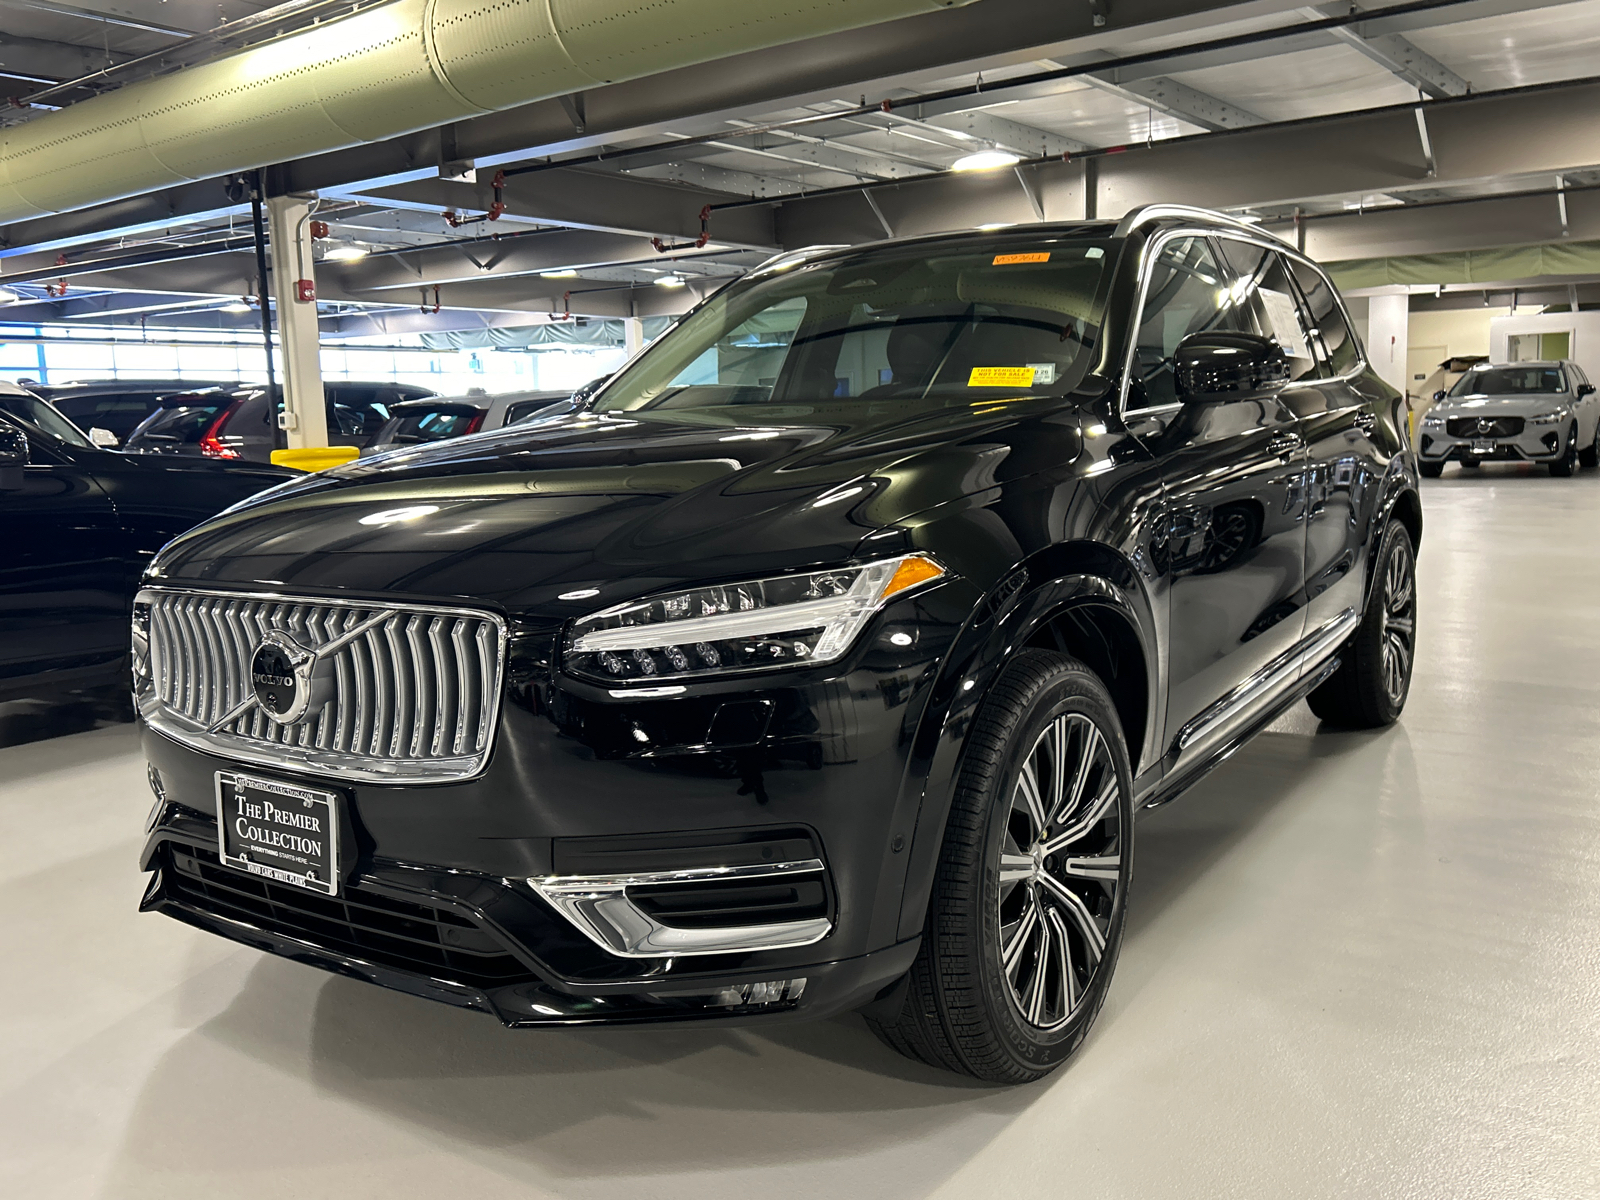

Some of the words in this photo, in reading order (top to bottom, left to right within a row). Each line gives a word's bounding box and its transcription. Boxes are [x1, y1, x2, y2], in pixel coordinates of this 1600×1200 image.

[253, 672, 293, 687] VOLVO
[234, 794, 263, 820] THE
[263, 800, 321, 833] PREMIER
[235, 817, 322, 857] COLLECTION
[250, 845, 279, 857] EVERYTHING
[278, 851, 296, 861] STARTS
[247, 861, 262, 874] VOLVO
[261, 865, 274, 878] CARS
[274, 869, 290, 882] WHITE
[289, 873, 306, 887] PLAINS
